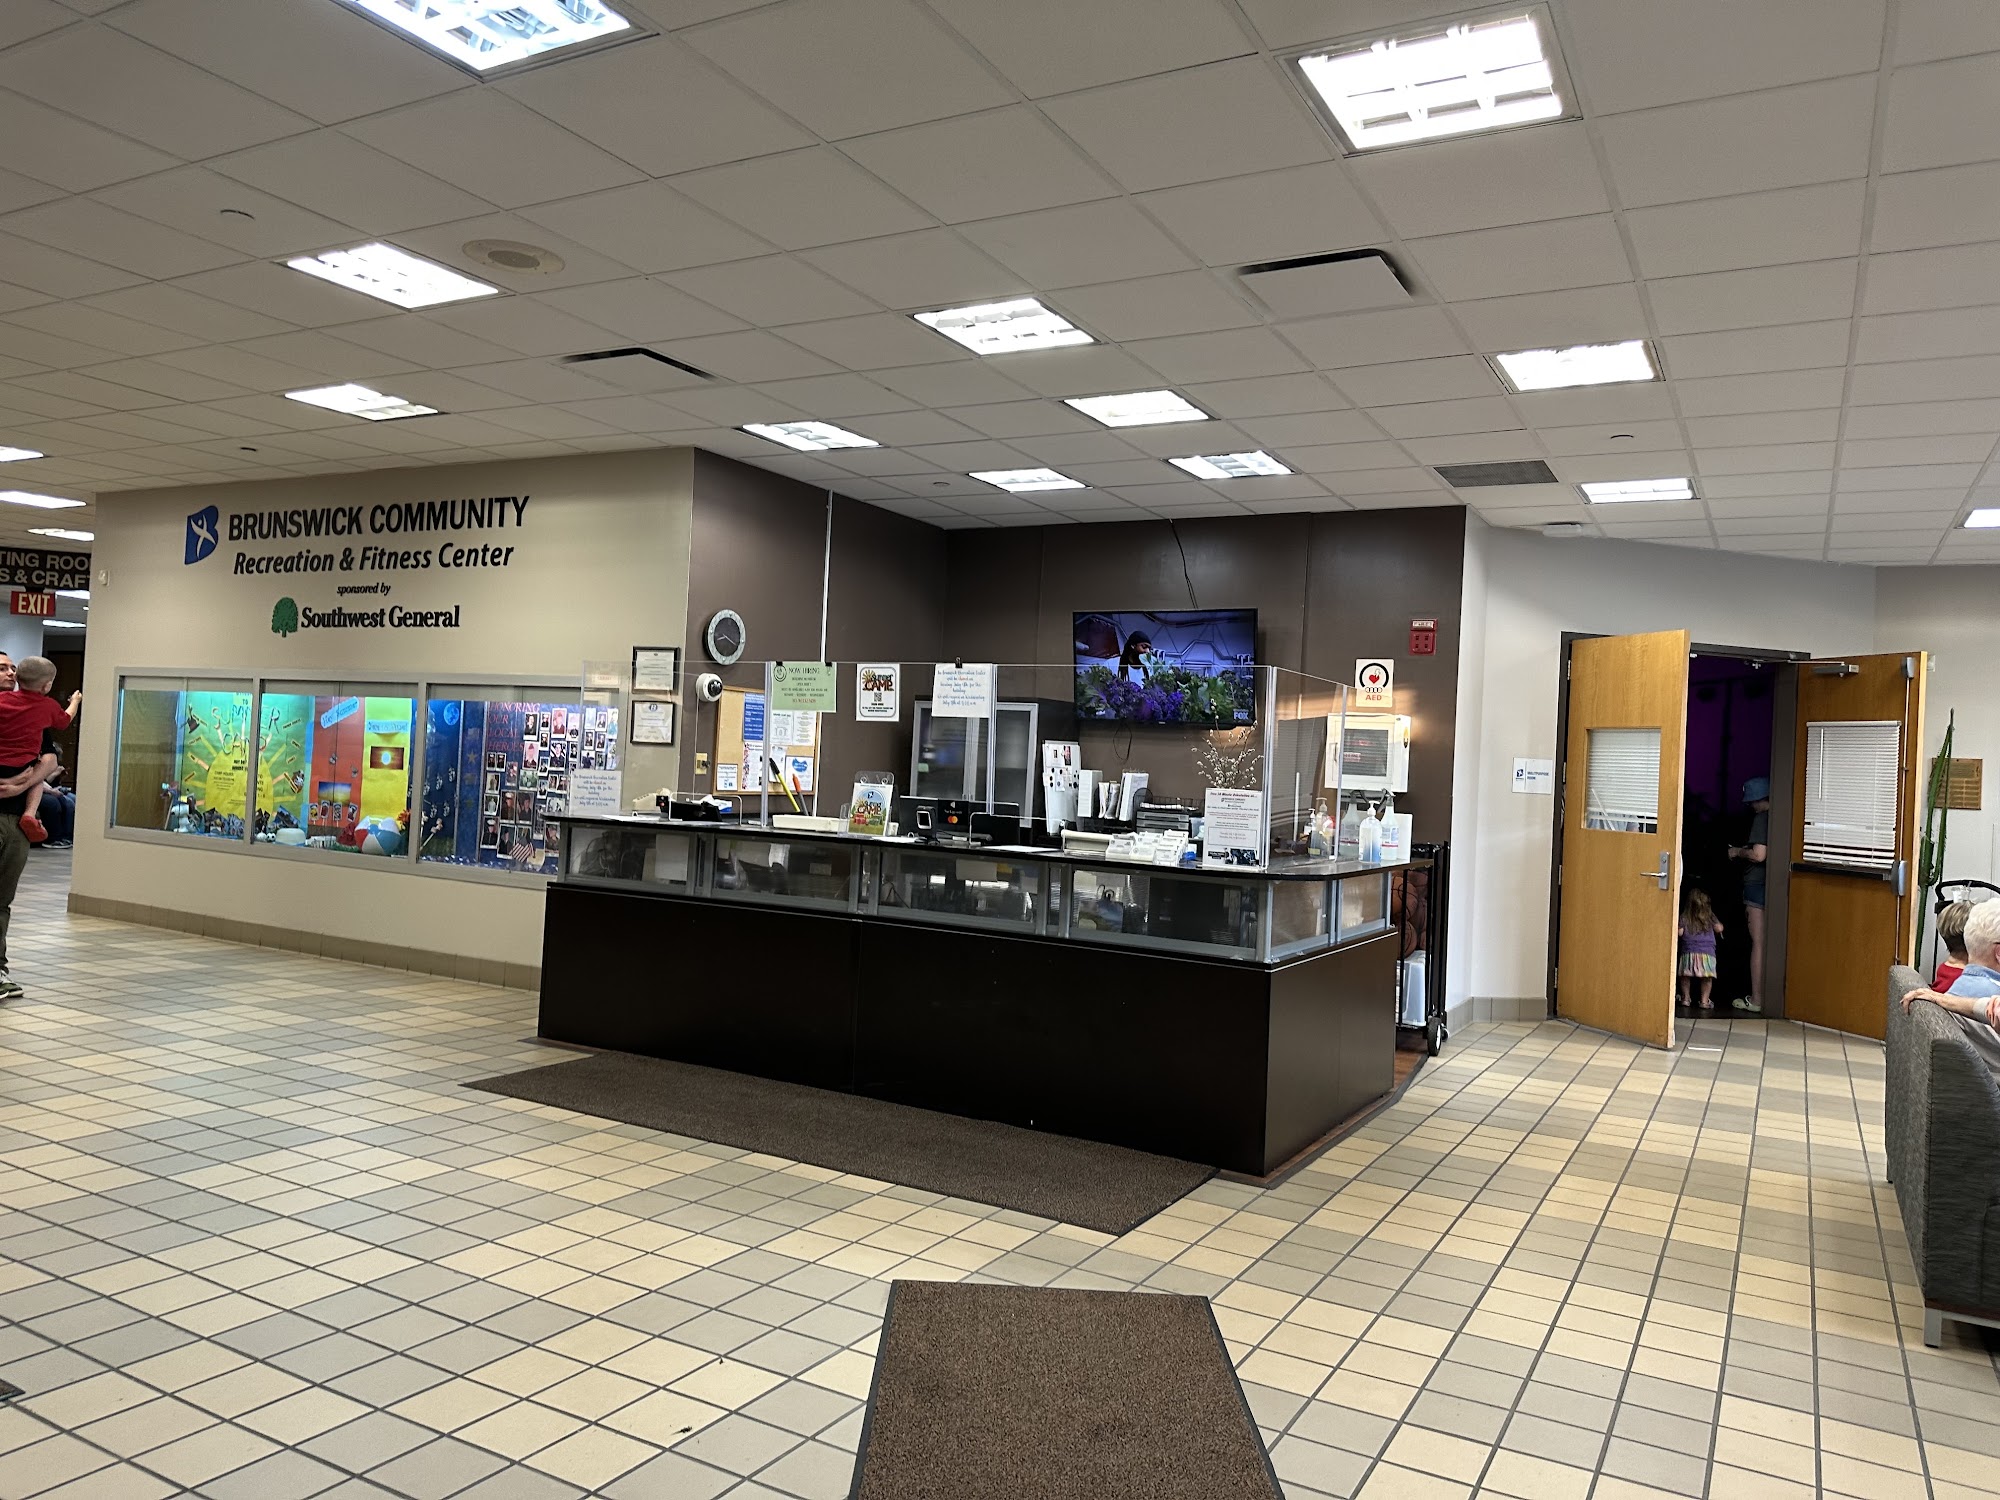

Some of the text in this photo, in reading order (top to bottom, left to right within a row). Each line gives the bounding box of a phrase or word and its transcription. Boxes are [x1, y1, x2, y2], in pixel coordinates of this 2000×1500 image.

[228, 495, 529, 541] BRUNSWICK COMMUNITY
[46, 554, 91, 571] ROO
[233, 542, 514, 575] Recreation & Fitness Center
[14, 569, 28, 584] &
[337, 582, 391, 596] sponsored by
[17, 593, 50, 615] EXIT
[301, 605, 460, 628] Southwest General
[863, 680, 894, 691] CAMP
[488, 702, 540, 713] HONORING
[488, 714, 509, 725] OUR
[1233, 711, 1249, 720] FOX
[487, 728, 518, 738] LOCAL
[487, 741, 524, 752] HEROES
